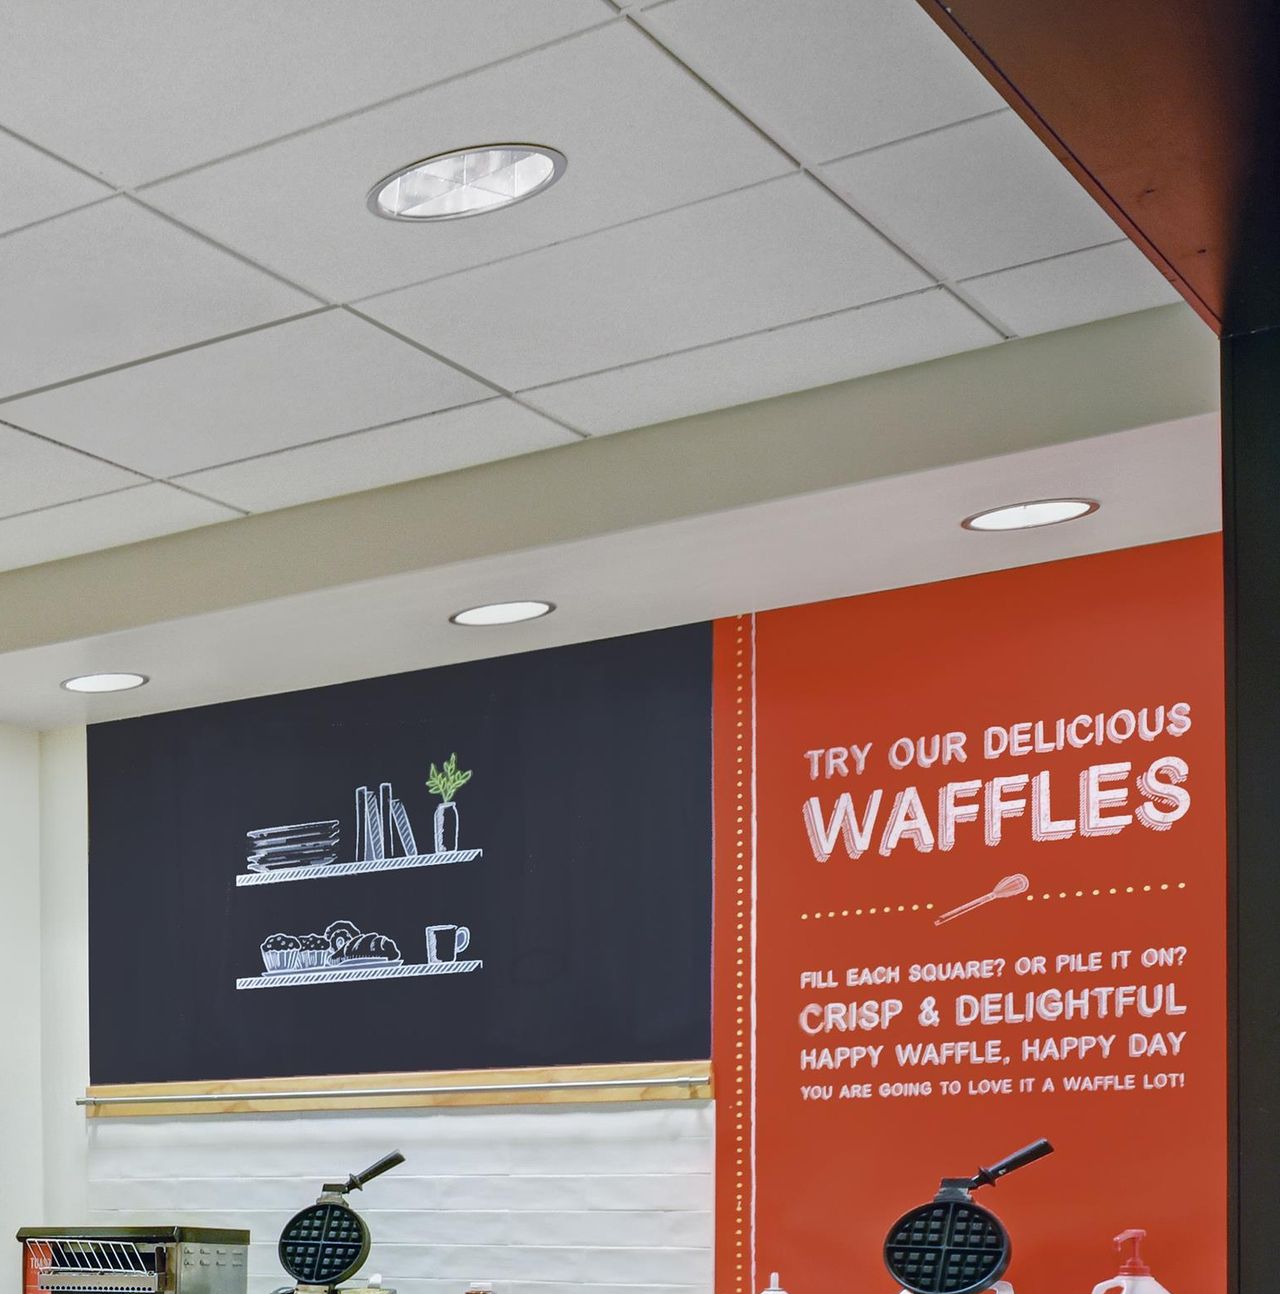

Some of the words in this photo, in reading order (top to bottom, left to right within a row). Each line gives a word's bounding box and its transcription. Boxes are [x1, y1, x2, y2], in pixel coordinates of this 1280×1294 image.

[804, 743, 872, 780] TRY
[888, 732, 967, 769] OUR
[984, 703, 1191, 759] DELICIOUS
[802, 756, 1190, 862] WAFFLES
[800, 970, 838, 989] FILL
[846, 966, 899, 986] EACH
[909, 958, 1005, 982] SQUARE?
[1015, 956, 1046, 975] OR
[1056, 952, 1102, 973] PILE
[1112, 950, 1131, 969] IT
[1141, 946, 1187, 967] ON?
[799, 999, 903, 1035] CRISP
[918, 996, 940, 1027] &
[956, 983, 1187, 1026] DELIGHTFUL
[801, 1045, 884, 1070] HAPPY
[895, 1040, 1010, 1066] WAFFLE,
[1022, 1035, 1116, 1061] HAPPY
[1129, 1032, 1186, 1057] DAY
[801, 1086, 833, 1100] YOU
[839, 1084, 872, 1098] ARE
[879, 1081, 932, 1097] GOING
[940, 1081, 961, 1095] TO
[969, 1079, 1012, 1095] LOVE
[1020, 1078, 1035, 1092] IT
[1042, 1078, 1054, 1092] A
[1063, 1075, 1135, 1091] WAFFLE
[1143, 1073, 1184, 1089] LOT!
